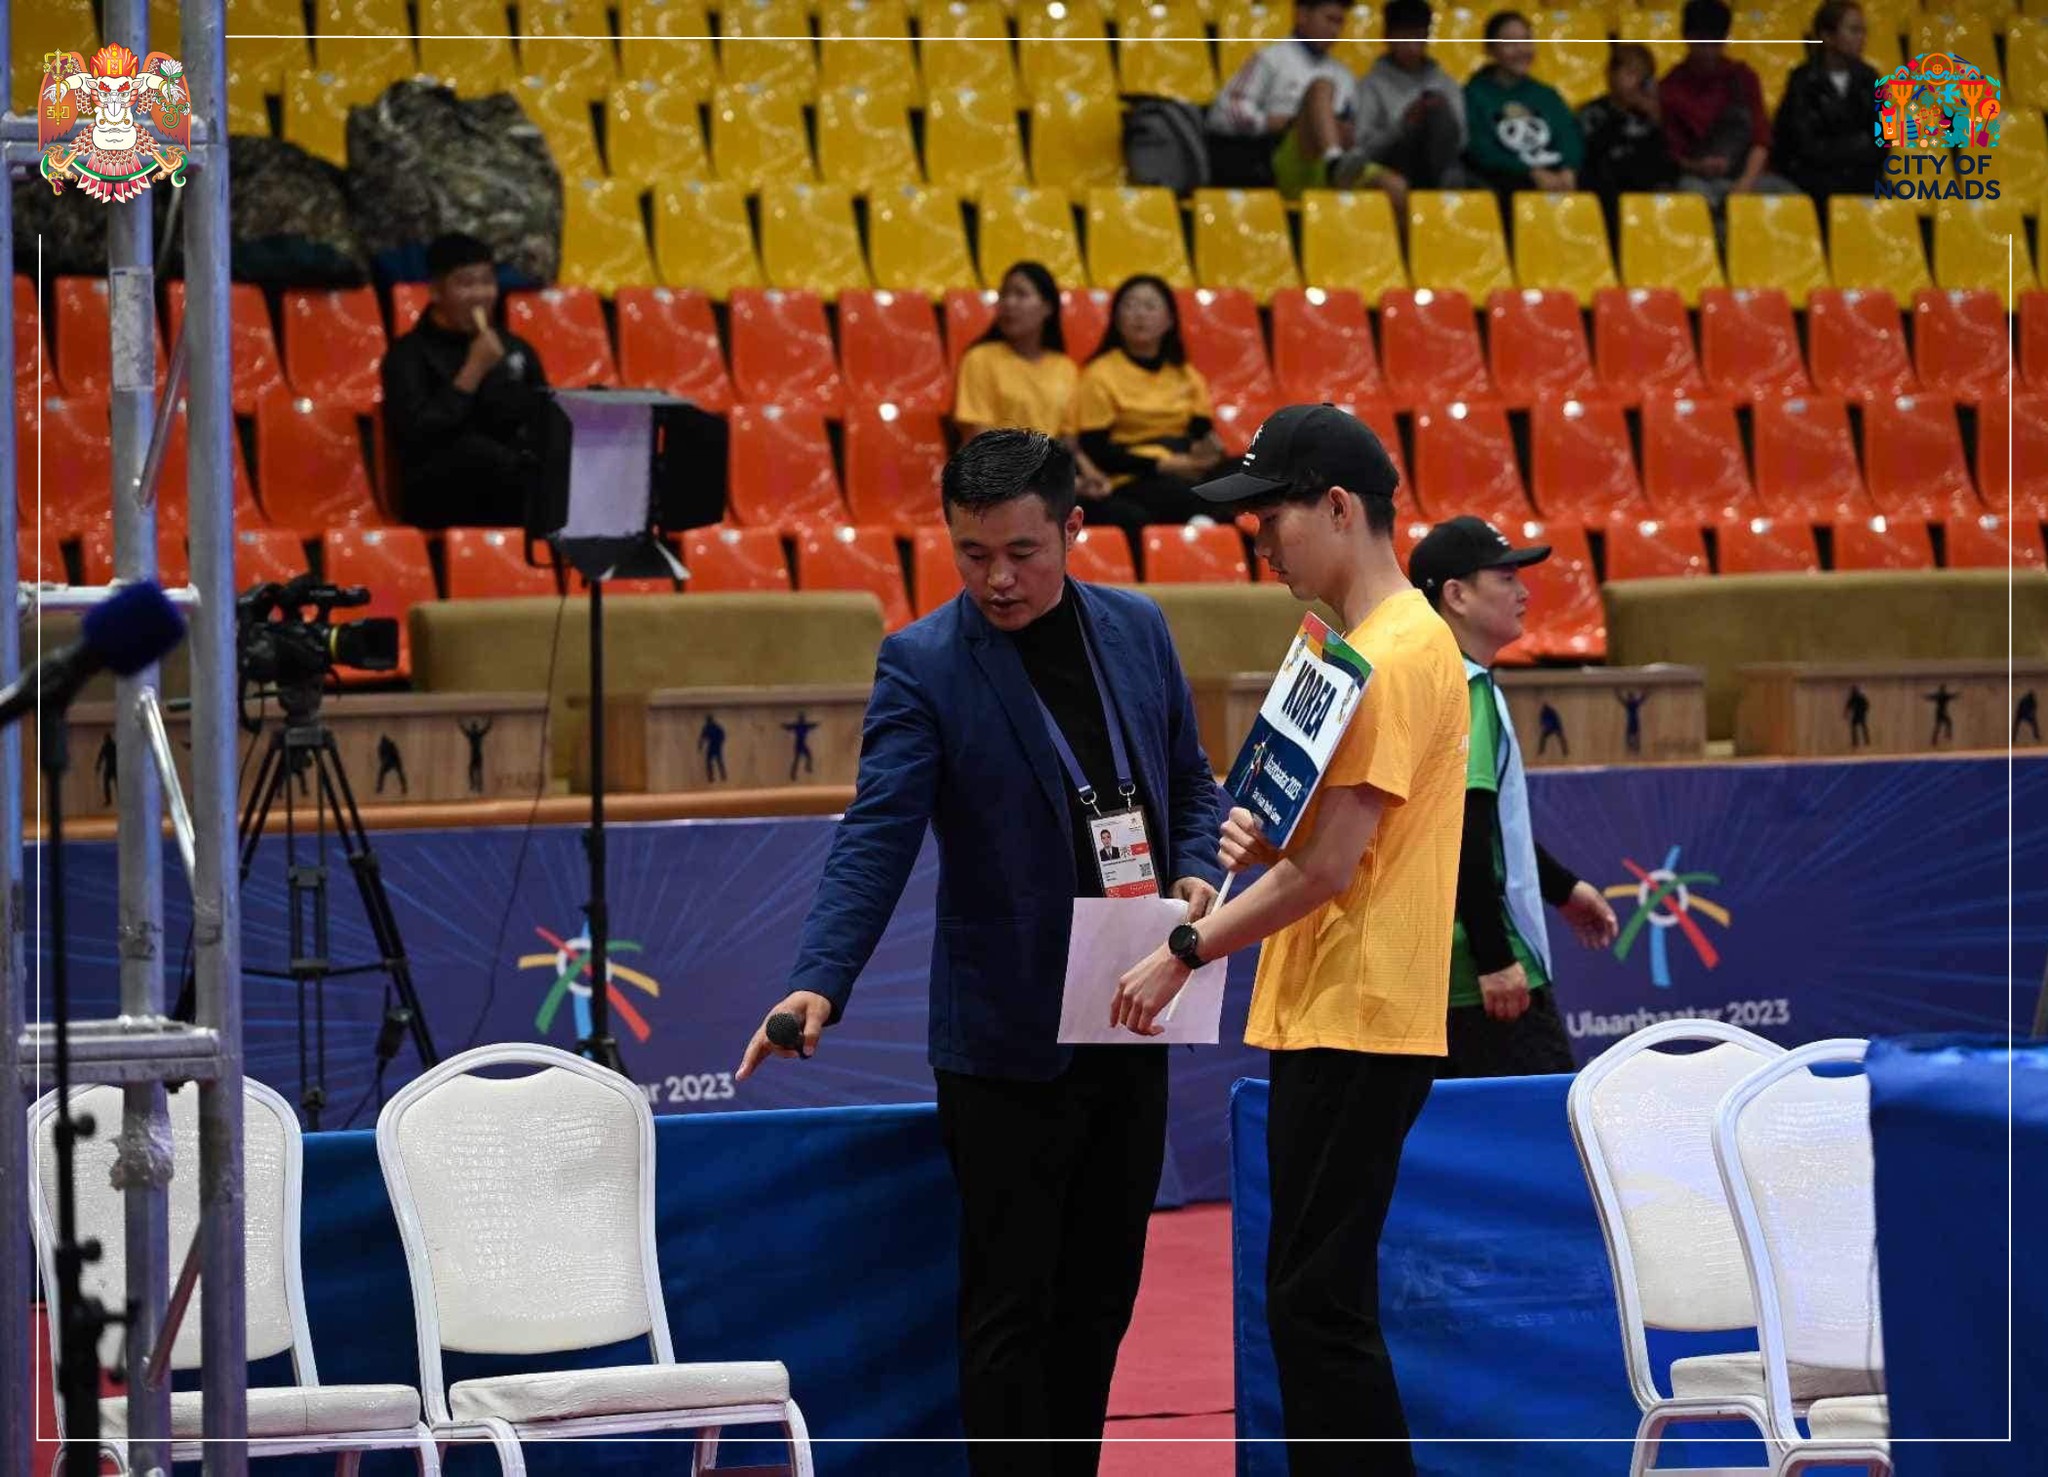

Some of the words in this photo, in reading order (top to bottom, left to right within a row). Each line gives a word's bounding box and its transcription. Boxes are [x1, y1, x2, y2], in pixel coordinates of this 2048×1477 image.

[1281, 659, 1338, 742] KOREA
[1726, 998, 1790, 1026] 2023
[665, 1072, 735, 1102] 2023
